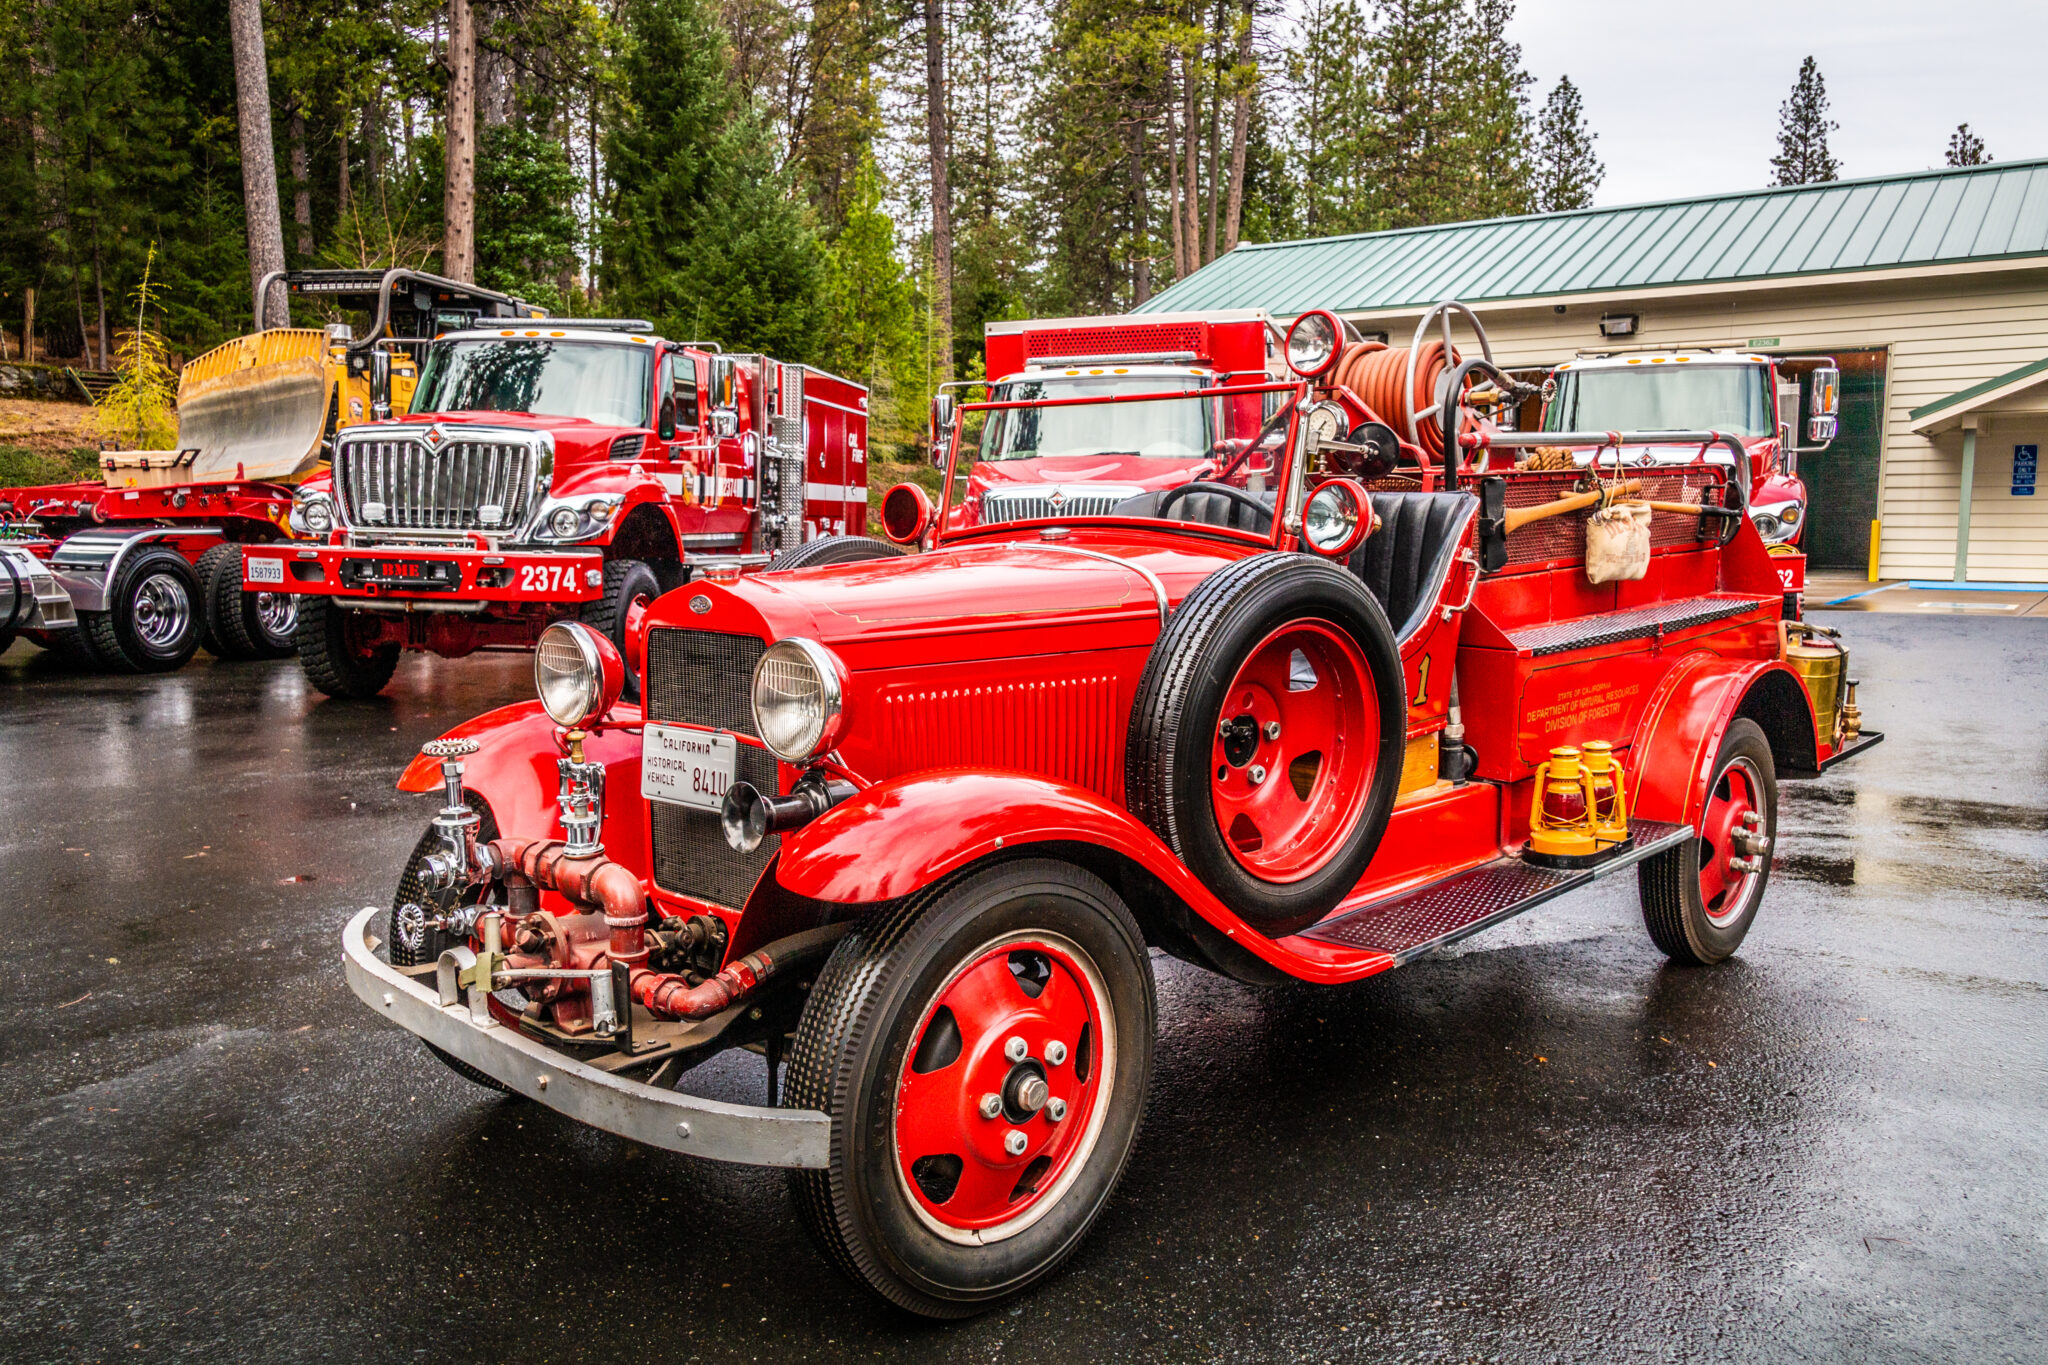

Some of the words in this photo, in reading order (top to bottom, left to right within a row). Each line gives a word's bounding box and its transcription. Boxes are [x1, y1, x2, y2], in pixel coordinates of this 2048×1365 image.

[848, 432, 858, 448] CAL
[852, 448, 864, 463] FIRE
[723, 478, 737, 497] 2374
[251, 566, 281, 579] 1587933
[382, 563, 420, 577] BME
[521, 565, 576, 592] 2374
[1413, 652, 1431, 707] 1
[1557, 690, 1573, 701] STATE
[1574, 688, 1581, 697] OF
[1581, 681, 1611, 695] CALIFORNIA
[1527, 701, 1570, 723] DEPARTMENT
[1570, 699, 1579, 711] OF
[1579, 693, 1605, 708] NATURAL
[1605, 683, 1640, 701] RESOURCES
[1545, 713, 1577, 733] DIVISION
[1578, 710, 1588, 724] OF
[1588, 701, 1621, 720] FORESTRY
[663, 738, 711, 755] CALIFORNIA
[647, 755, 687, 772] HISTORICAL
[647, 771, 675, 786] VEHICLE
[693, 767, 727, 797] 841U
